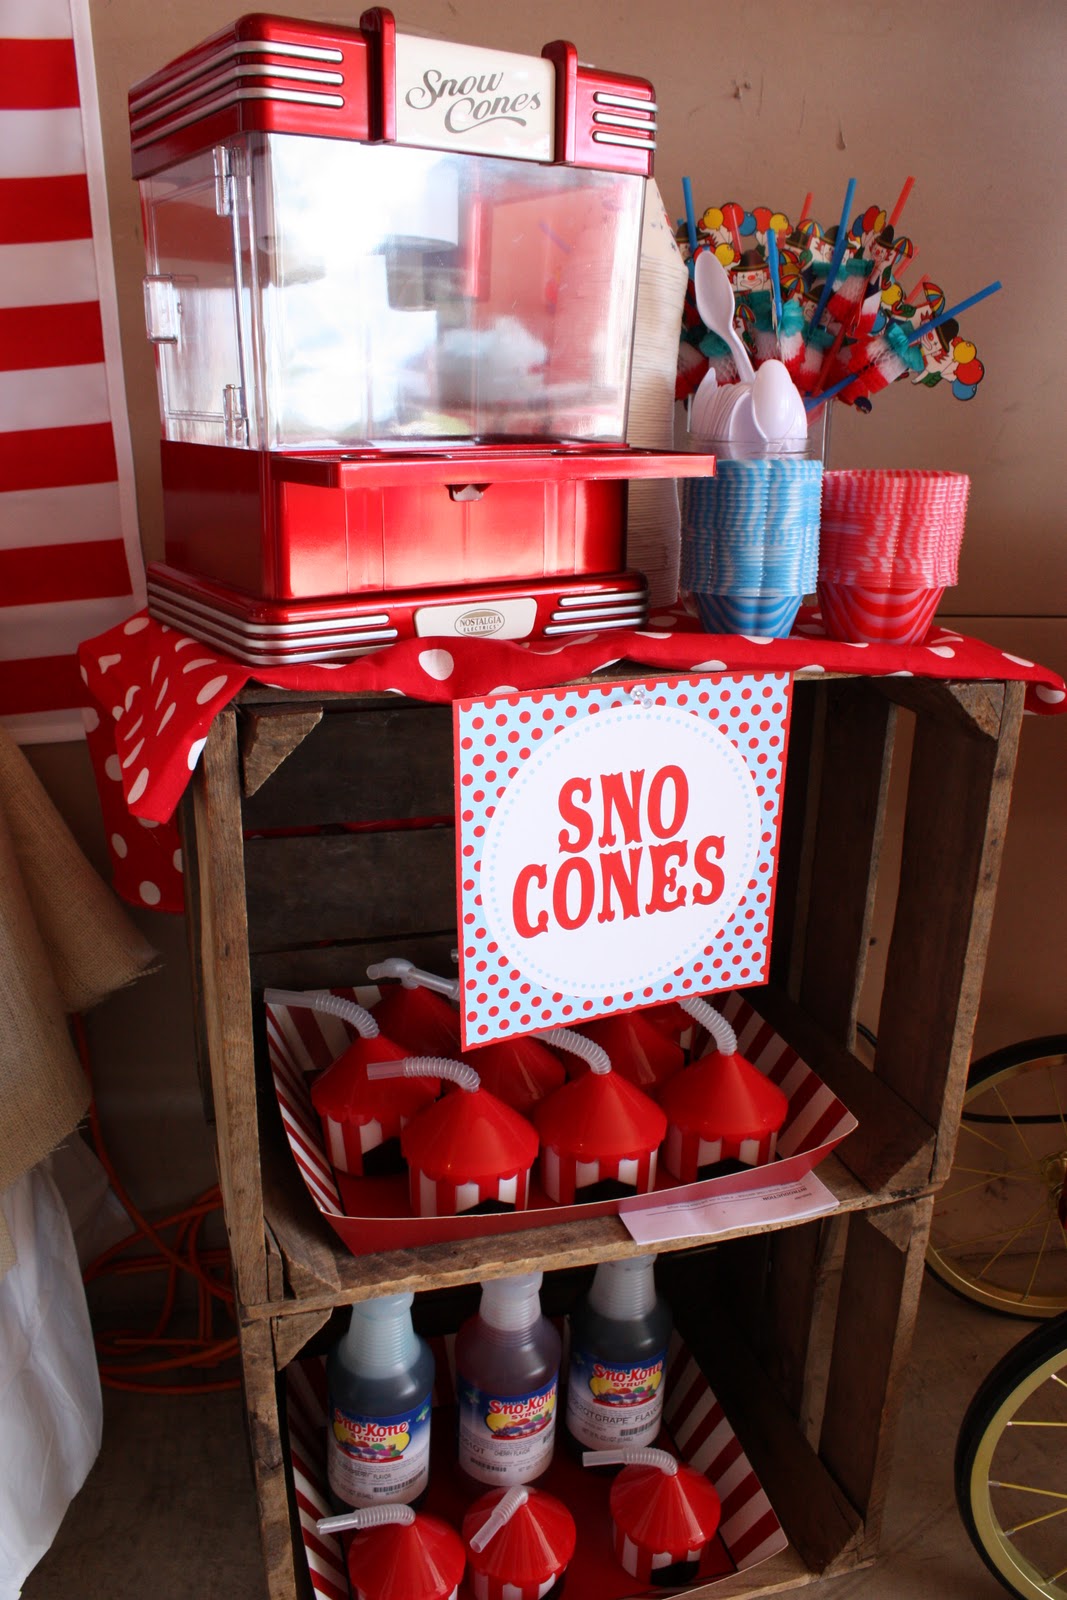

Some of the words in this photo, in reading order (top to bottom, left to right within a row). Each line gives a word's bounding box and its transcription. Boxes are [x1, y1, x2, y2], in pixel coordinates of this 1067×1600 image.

[405, 69, 504, 110] Snow
[444, 91, 541, 134] Cones
[459, 615, 502, 627] NOSTALGIA
[463, 624, 497, 633] ELECTRICS
[557, 764, 690, 854] SNO
[511, 834, 726, 939] CONES
[612, 1379, 647, 1388] SYRUP
[334, 1407, 409, 1438] Sno-Kone
[511, 1406, 544, 1420] SYRUP
[350, 1432, 387, 1443] SYRUP
